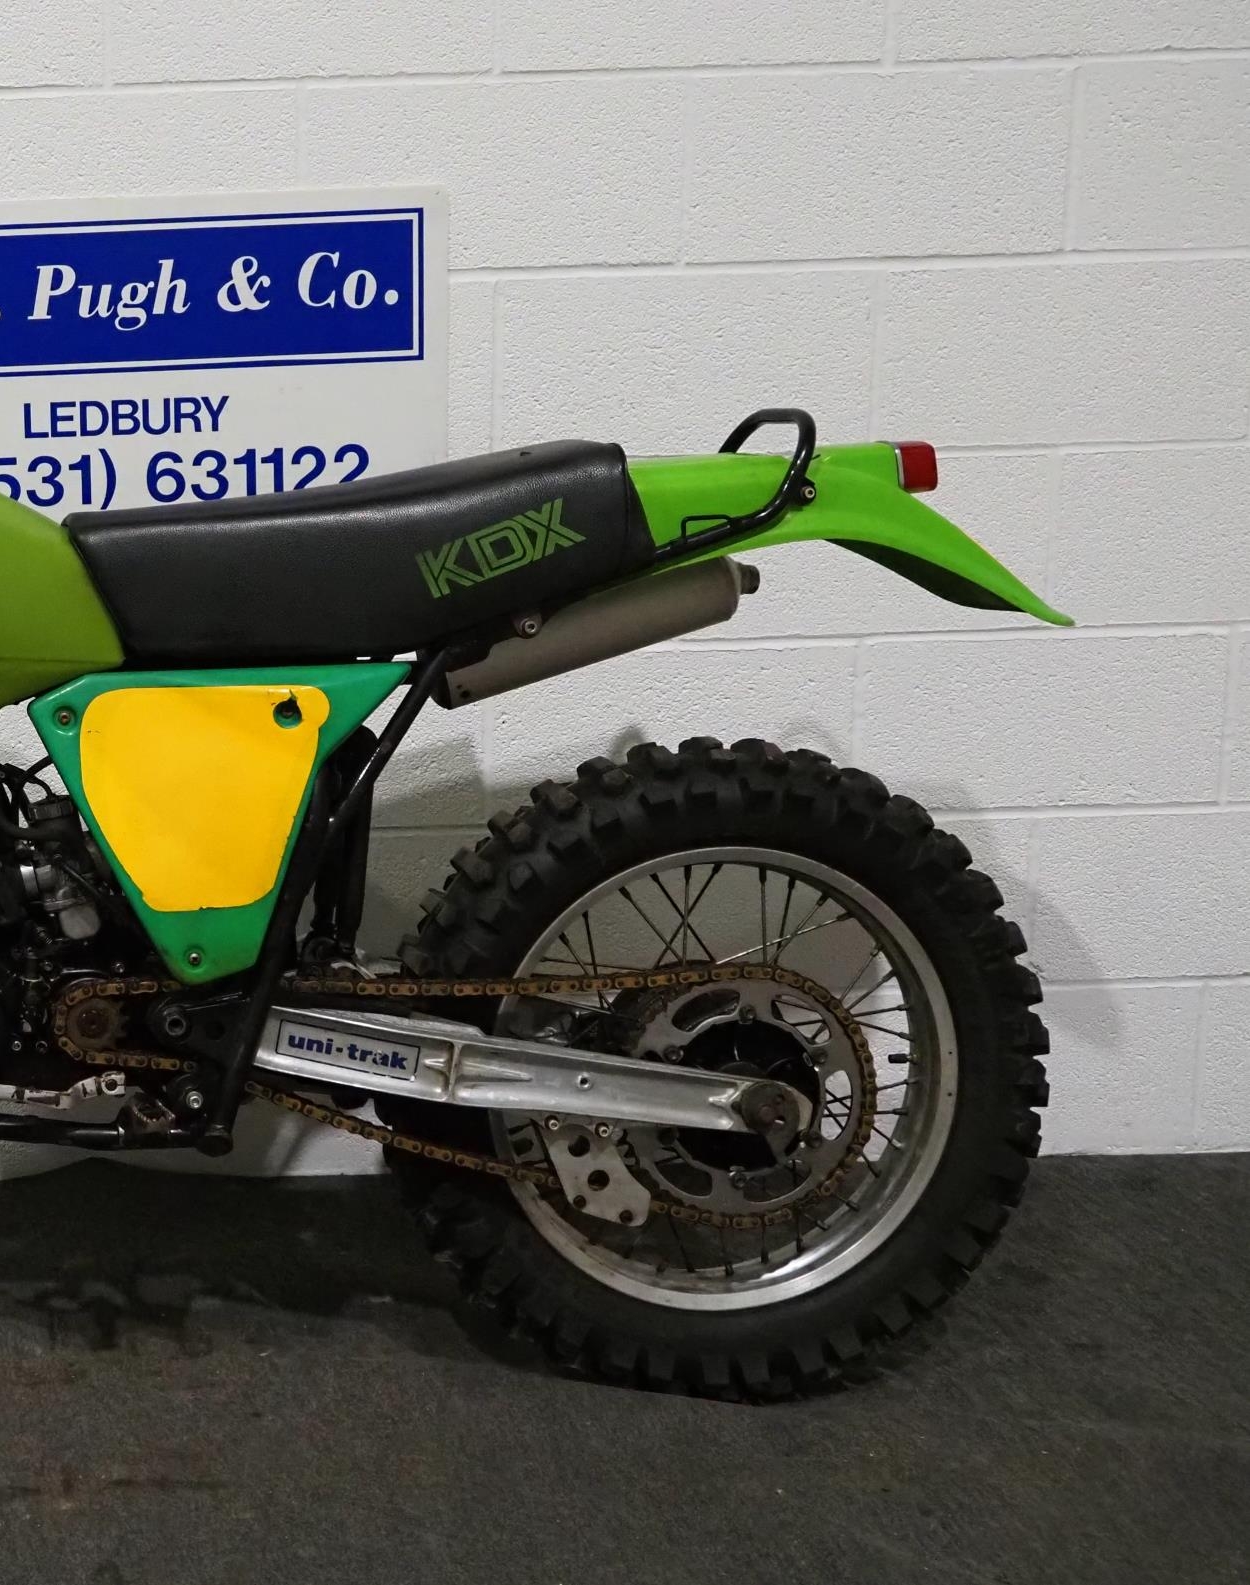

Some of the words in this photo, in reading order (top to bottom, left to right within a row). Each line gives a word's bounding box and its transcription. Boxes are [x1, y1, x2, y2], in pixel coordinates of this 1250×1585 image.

[27, 258, 191, 331] Pugh
[216, 255, 271, 313] &
[297, 251, 399, 309] Co.
[23, 396, 229, 439] LEDBURY
[146, 443, 370, 503] 631122
[414, 498, 587, 599] KDX
